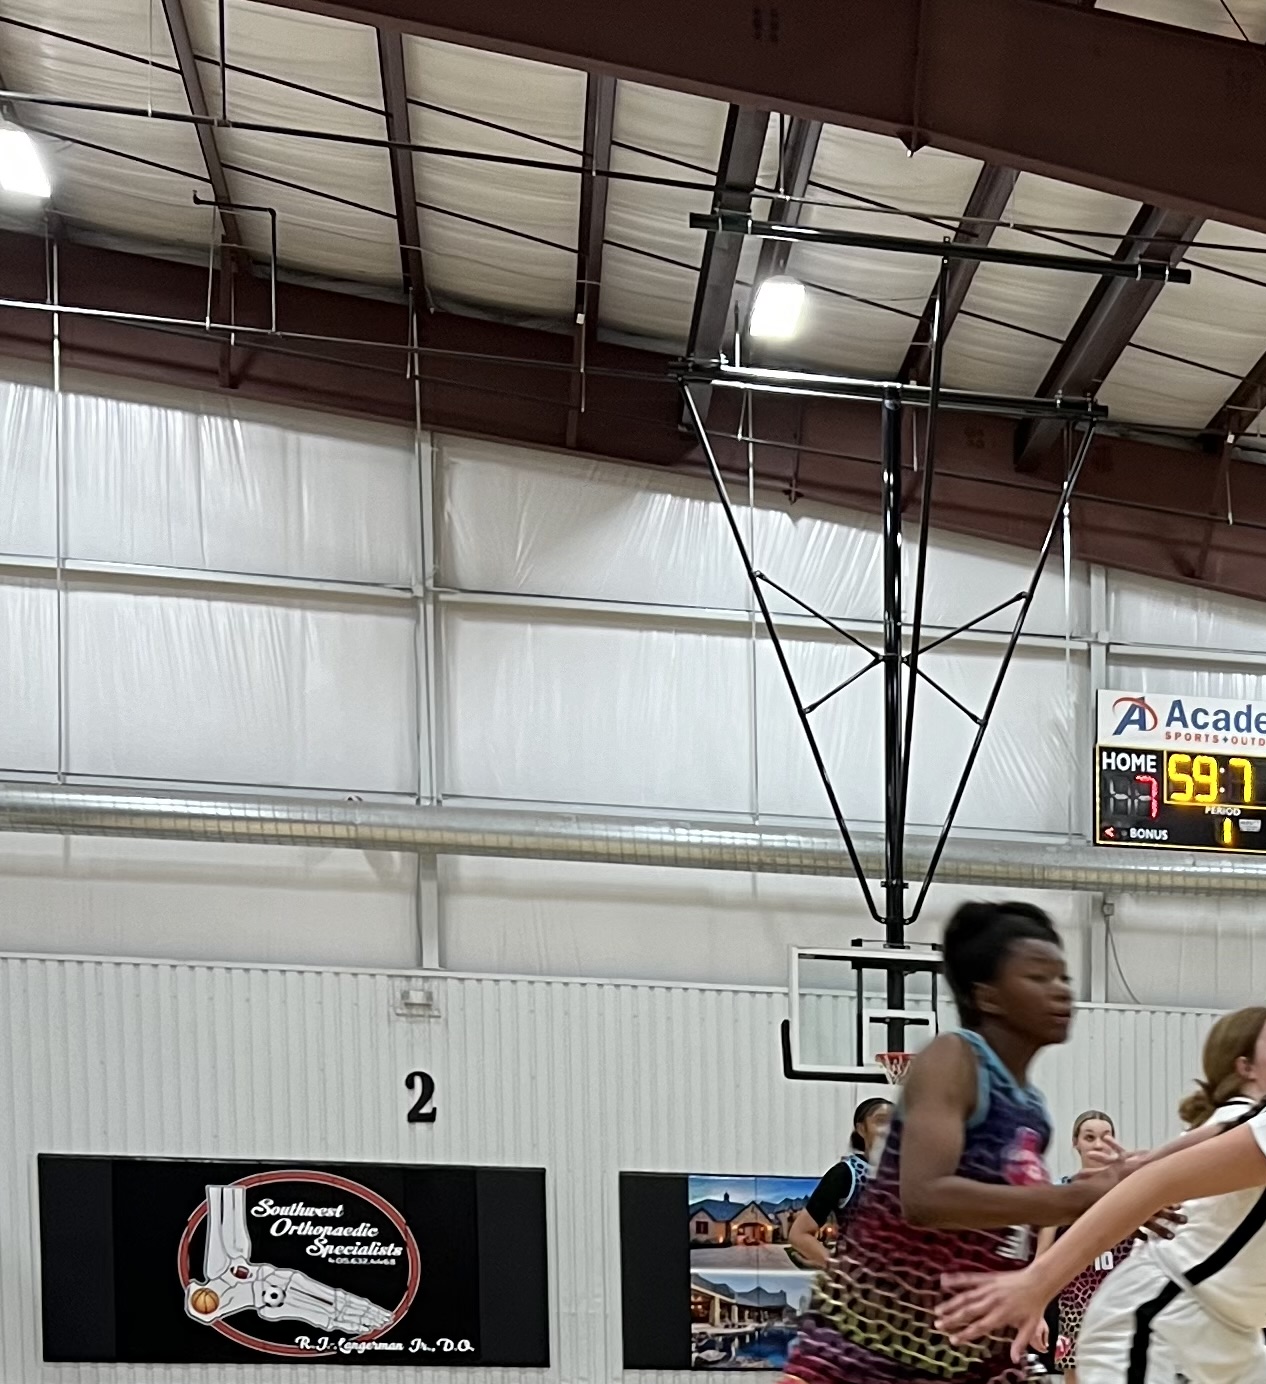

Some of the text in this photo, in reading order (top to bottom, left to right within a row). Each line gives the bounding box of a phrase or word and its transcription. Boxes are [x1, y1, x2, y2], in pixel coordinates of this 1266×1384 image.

[1102, 751, 1157, 773] HOME
[1204, 806, 1241, 816] PERIOD
[1129, 827, 1168, 841] BONUS
[1223, 817, 1232, 844] 1
[405, 1071, 437, 1123] 2
[250, 1198, 344, 1218] Southwest
[270, 1218, 379, 1238] Orthopaedic
[306, 1237, 403, 1258] Specialists
[1095, 1251, 1114, 1271] 10
